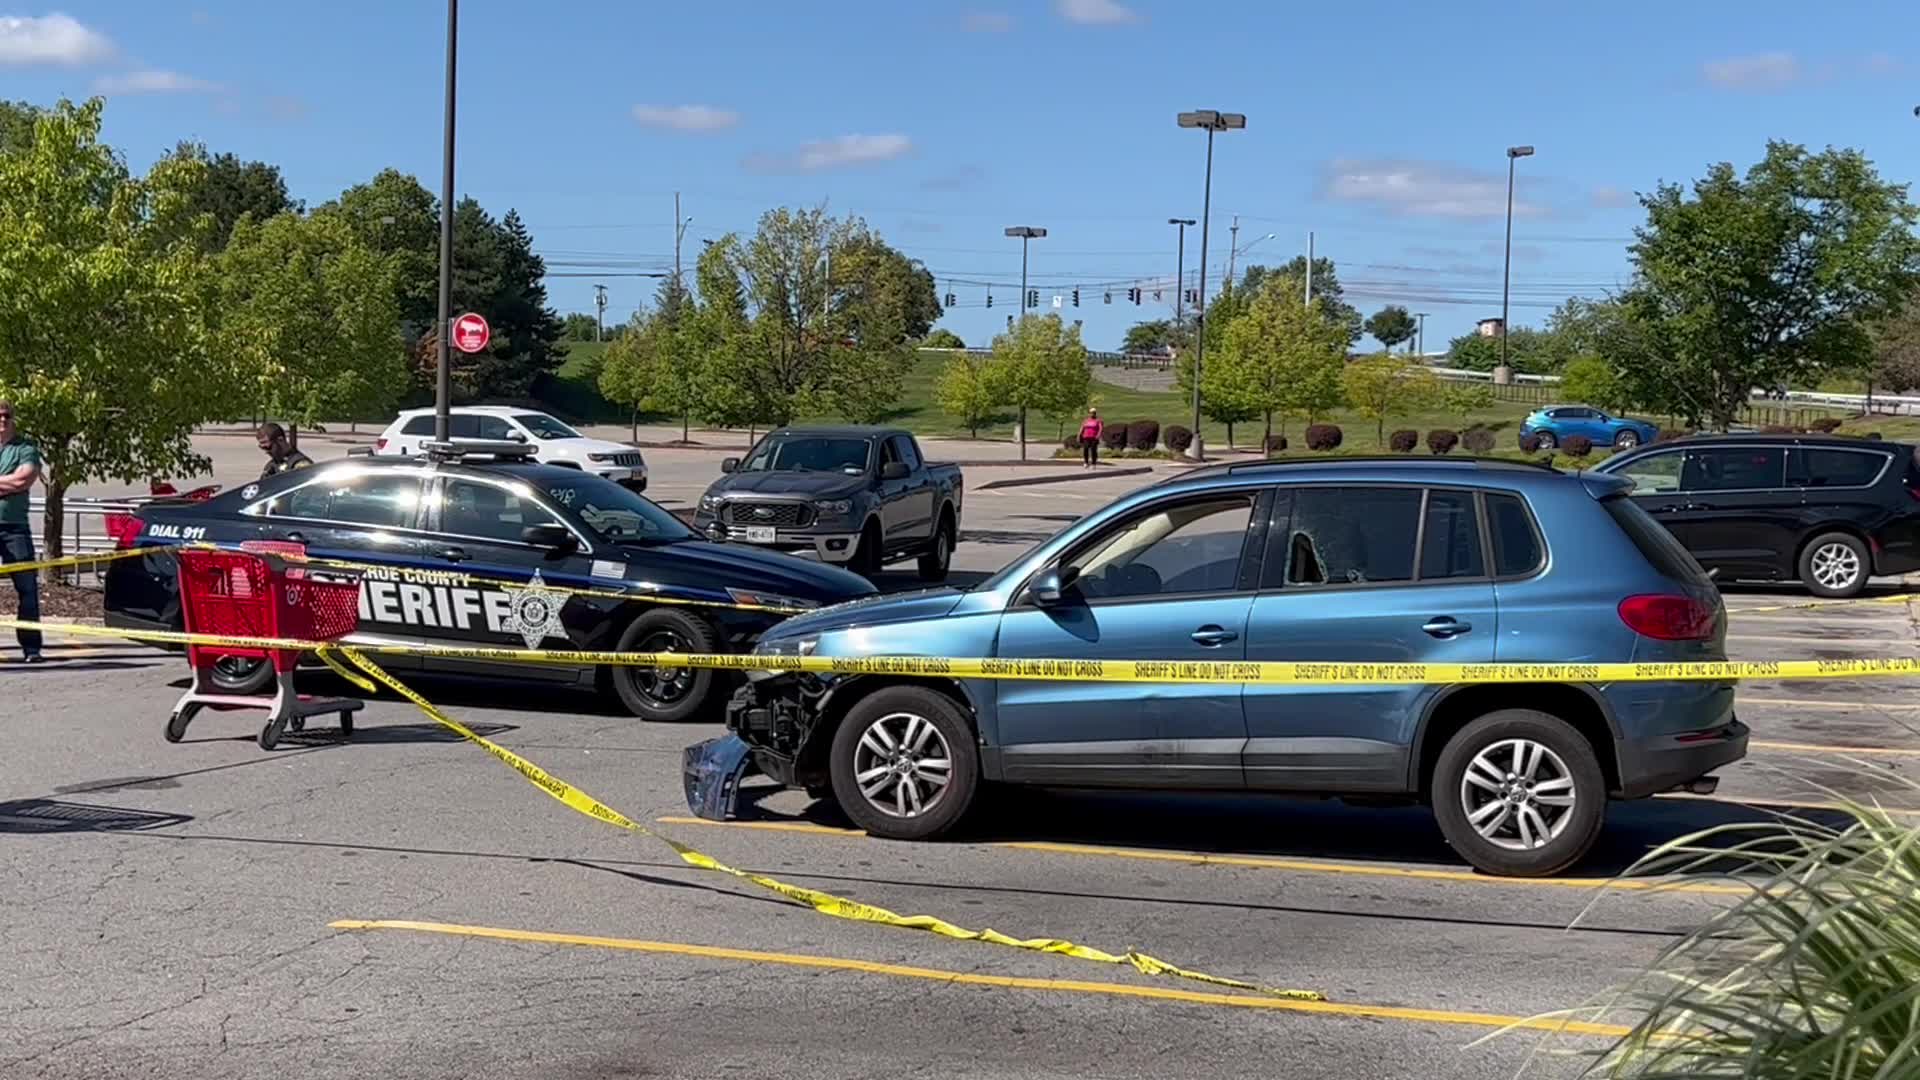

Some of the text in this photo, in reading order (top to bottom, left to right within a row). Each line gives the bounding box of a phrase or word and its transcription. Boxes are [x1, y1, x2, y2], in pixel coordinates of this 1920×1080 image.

[149, 524, 206, 539] DIAL 911
[404, 568, 470, 587] COUNTY
[358, 580, 511, 632] ERIFF
[874, 658, 891, 672] LINE
[892, 658, 904, 672] DO
[905, 658, 921, 672] NOT
[923, 658, 950, 673] CROSS
[1023, 660, 1041, 675] LINE
[1043, 660, 1055, 676] DO
[1057, 660, 1072, 676] NOT
[1074, 661, 1103, 676] CROSS
[1179, 663, 1197, 679] LINE
[1199, 663, 1211, 679] DO
[1214, 663, 1230, 679] NOT
[1232, 663, 1260, 680] CROSS
[1339, 665, 1360, 679] LINE
[1362, 665, 1374, 680] DO
[1377, 665, 1395, 680] NOT
[1396, 665, 1426, 680] CROSS
[1508, 665, 1529, 679] LINE
[1531, 665, 1543, 679] DO
[1546, 665, 1565, 679] NOT
[1567, 665, 1599, 679] CROSS
[1686, 664, 1706, 676] LINE
[1708, 663, 1722, 675] DO
[1725, 663, 1743, 675] NOT
[1746, 661, 1778, 674] CROSS
